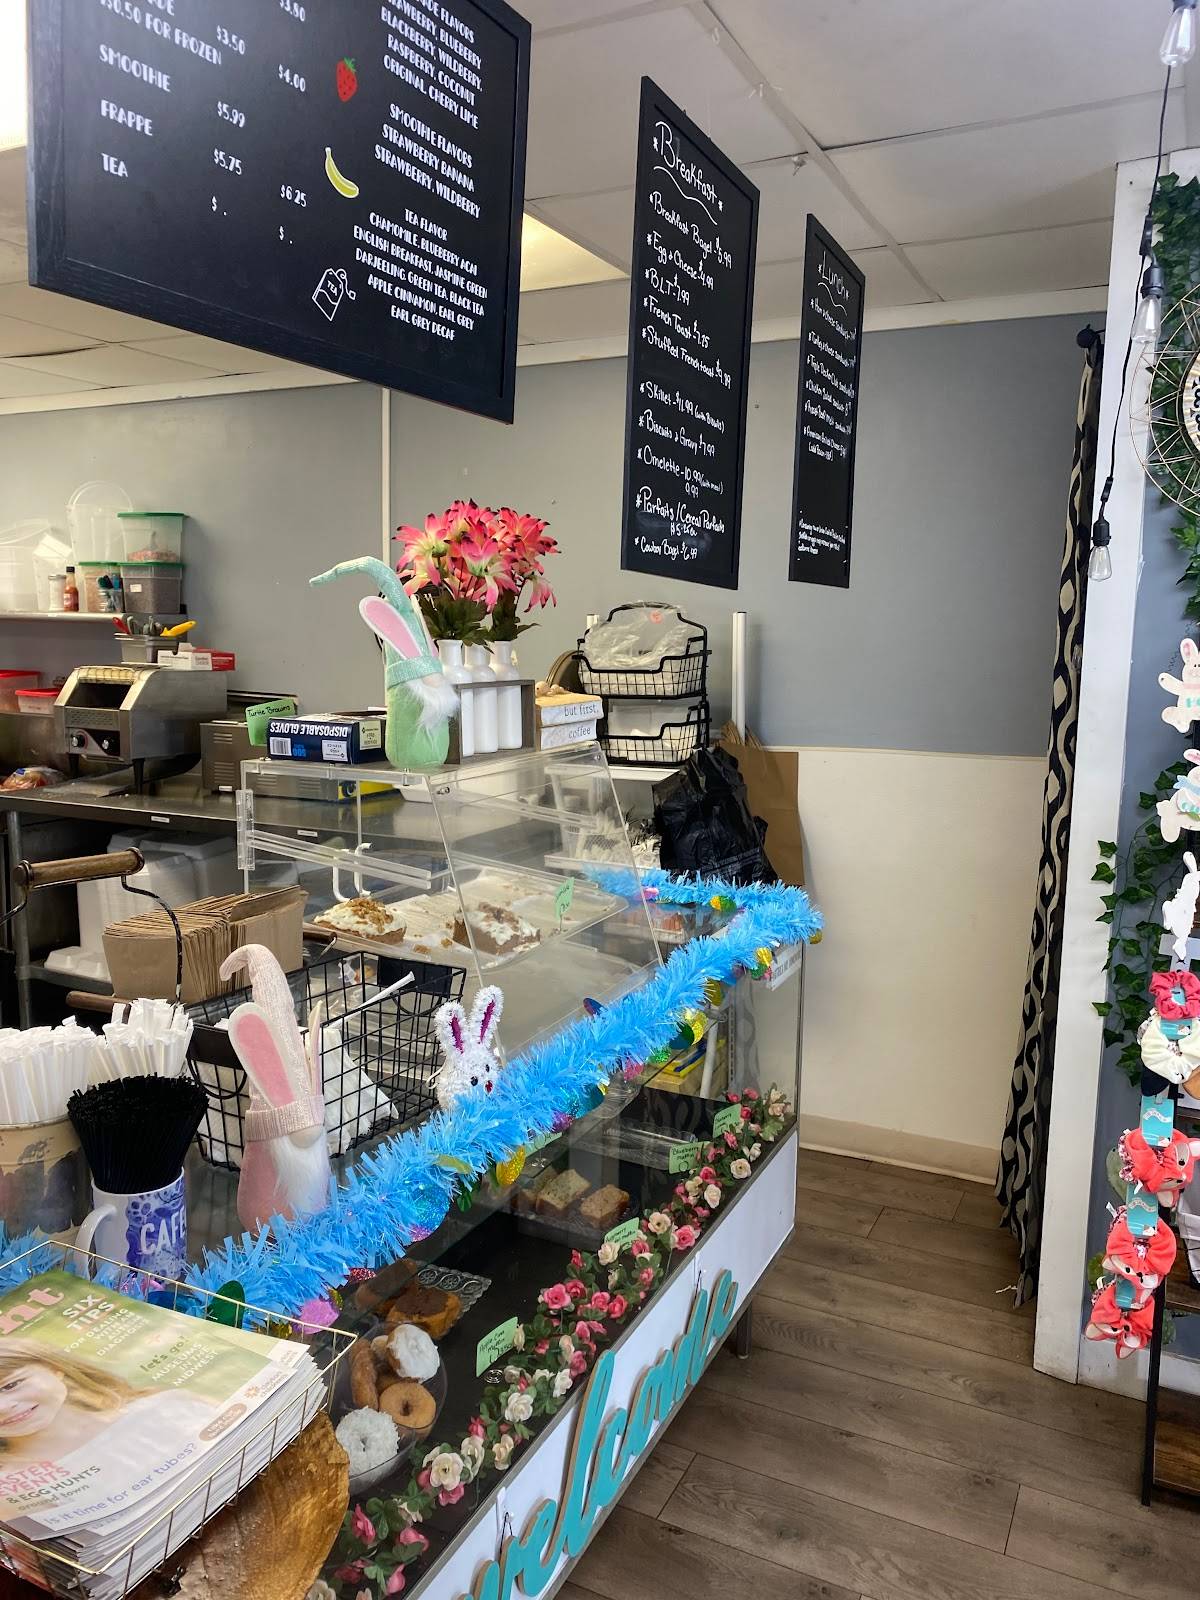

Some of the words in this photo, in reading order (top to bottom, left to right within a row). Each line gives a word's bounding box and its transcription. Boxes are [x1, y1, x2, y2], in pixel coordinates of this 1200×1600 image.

[145, 12, 172, 41] FOR
[174, 27, 222, 65] FROZEN
[216, 25, 245, 55] $3.50
[440, 7, 474, 43] FLAVORS
[381, 6, 436, 60] BLACKBERRY,
[438, 48, 482, 92] WILDBERRY,
[439, 28, 481, 70] BLUEBERRY
[99, 44, 170, 92] SMOOTHIE
[278, 64, 306, 92] $4.00
[428, 85, 459, 116] CHERRY
[459, 105, 479, 130] LIME
[438, 71, 475, 107] COCONUT
[100, 99, 153, 136] FRAPPE
[217, 101, 246, 128] $5.99
[389, 103, 437, 147] SMOOTHIE
[437, 134, 473, 168] FLAVORS
[101, 152, 128, 178] TEA
[213, 148, 242, 175] $5.75
[381, 123, 440, 171] STRAWBERRY
[441, 160, 475, 192] BANANA
[655, 121, 718, 204] Breakfast
[435, 180, 480, 218] WILDBERRY
[405, 208, 419, 226] TEA
[420, 217, 448, 241] FLAVOR
[652, 190, 690, 235] Breakfast
[690, 223, 712, 260] Bagel
[353, 225, 390, 253] ENGLISH
[390, 243, 434, 275] BREAKFAST,
[434, 264, 466, 289] JASMINE
[466, 280, 488, 299] GREEN
[369, 212, 420, 249] CHAMOMILE,
[420, 237, 460, 267] BLUEBERRY
[460, 258, 478, 276] ACAI
[652, 230, 668, 265] Egg
[673, 250, 697, 280] Cheese
[327, 279, 338, 297] TEA
[407, 271, 433, 292] GREEN
[449, 291, 472, 311] BLACK
[472, 301, 485, 316] TEA
[822, 251, 847, 300] Lunch
[367, 273, 393, 296] APPLE
[393, 286, 438, 315] CINNAMON,
[438, 305, 456, 323] EARL
[456, 313, 474, 331] GREY
[648, 295, 672, 327] French
[672, 313, 692, 340] Toast
[390, 304, 410, 324] EARL
[411, 314, 431, 331] GREY
[431, 321, 455, 341] DECAF
[646, 325, 679, 359] Stuffed
[643, 408, 672, 439] Biscuits
[679, 426, 698, 456] Gravy
[643, 445, 680, 477] Omelette
[640, 486, 674, 521] Parfaits
[270, 722, 299, 735] GLOVES
[300, 722, 348, 738] DISPOSABLE
[564, 706, 577, 717] but
[568, 727, 591, 739] coffee
[62, 1295, 103, 1319] SIX
[66, 1301, 115, 1331] TIPS
[63, 1337, 85, 1353] FOR
[86, 1308, 129, 1338] DEALING
[18, 1488, 51, 1502] EGG
[50, 1465, 101, 1491] HUNTS
[72, 1501, 108, 1518] time
[106, 1489, 129, 1505] for
[131, 1474, 154, 1492] ear
[153, 1442, 198, 1475] tubes?
